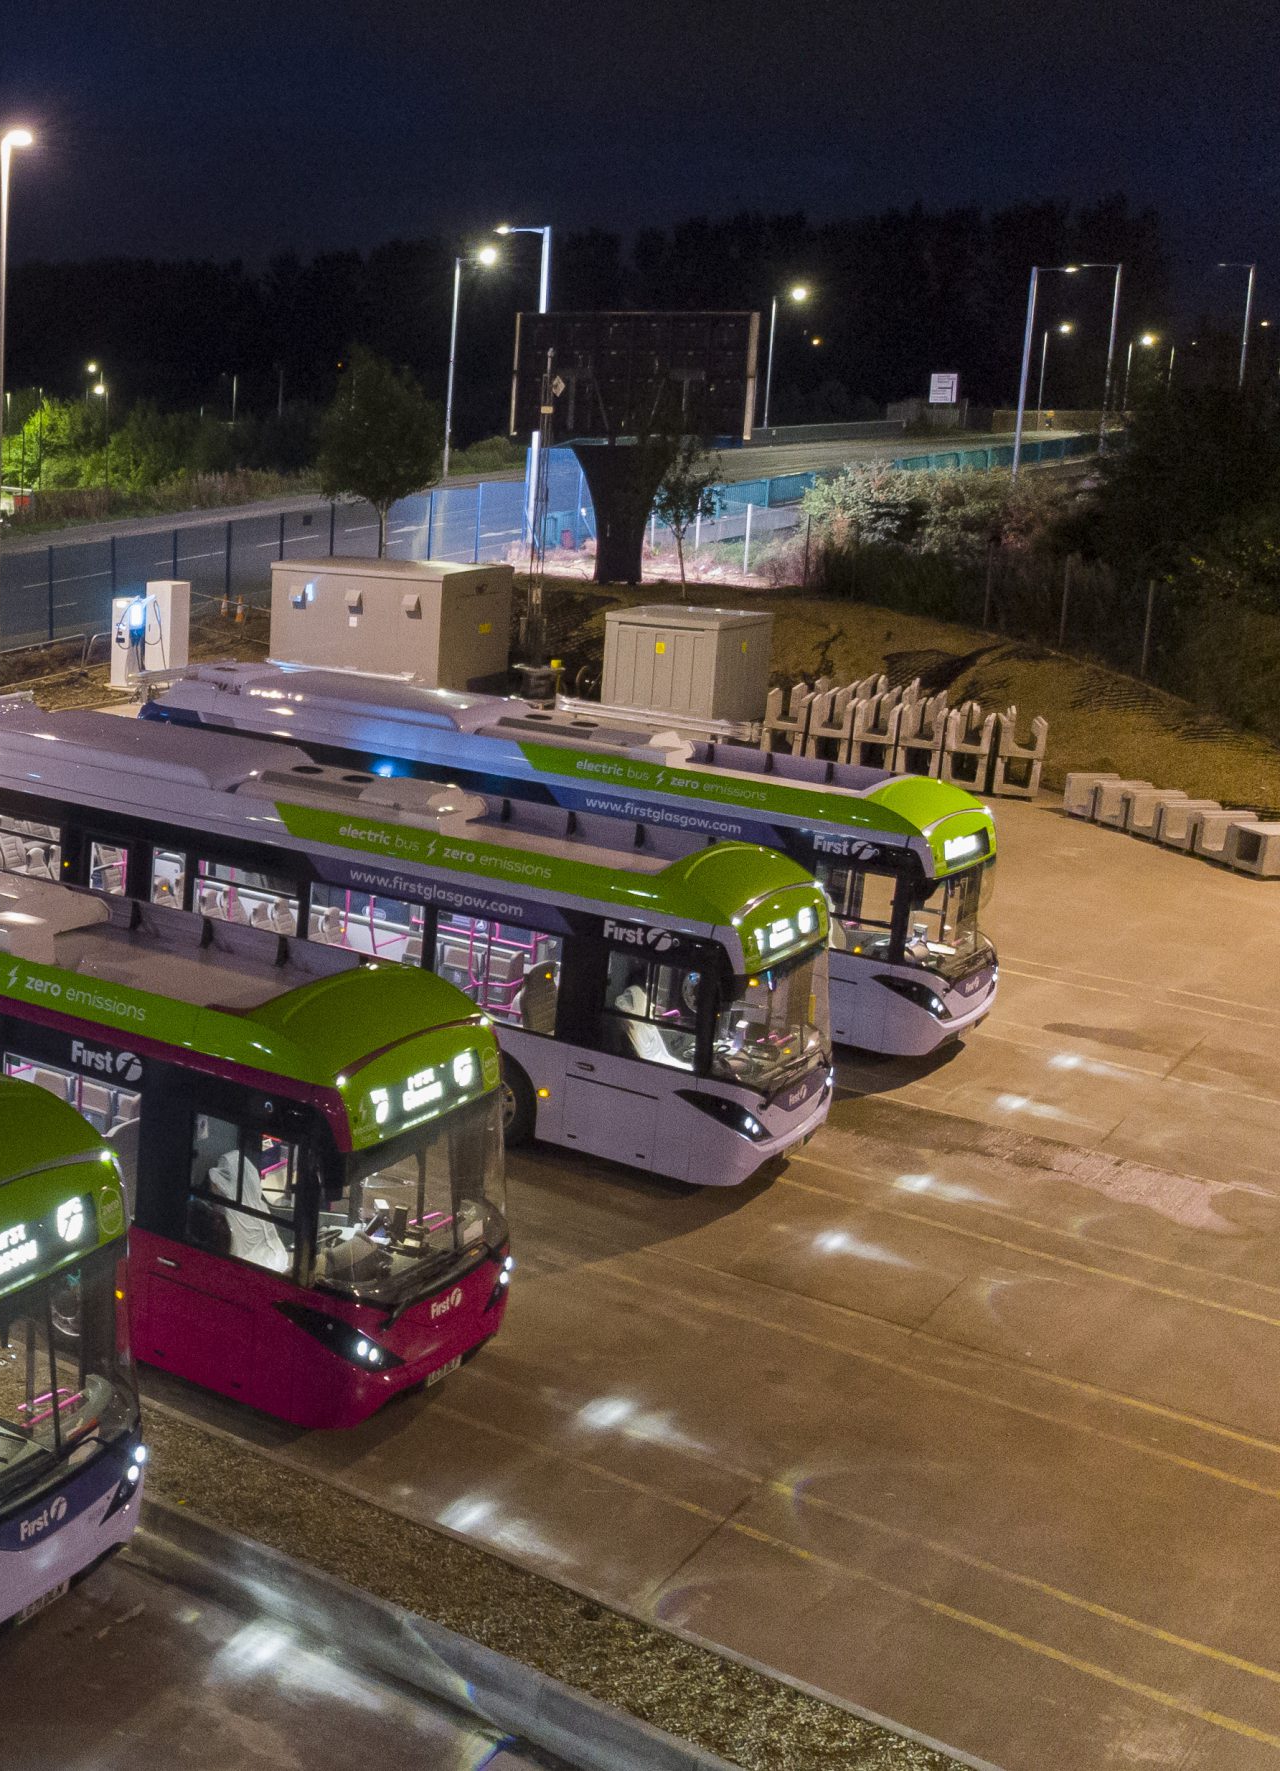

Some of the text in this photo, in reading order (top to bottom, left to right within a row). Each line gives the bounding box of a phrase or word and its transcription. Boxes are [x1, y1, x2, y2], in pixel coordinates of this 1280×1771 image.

[576, 759, 767, 801] electric bus zero emissions
[585, 798, 742, 835] www.firstglasgow.com
[339, 824, 552, 879] electric bus zero emissions
[813, 835, 848, 855] First
[350, 869, 524, 917] www.firstglasgow.com
[603, 919, 644, 945] First
[25, 975, 62, 997] zero
[65, 989, 146, 1021] emissions
[71, 1040, 113, 1074] First
[21, 1509, 49, 1541] First
